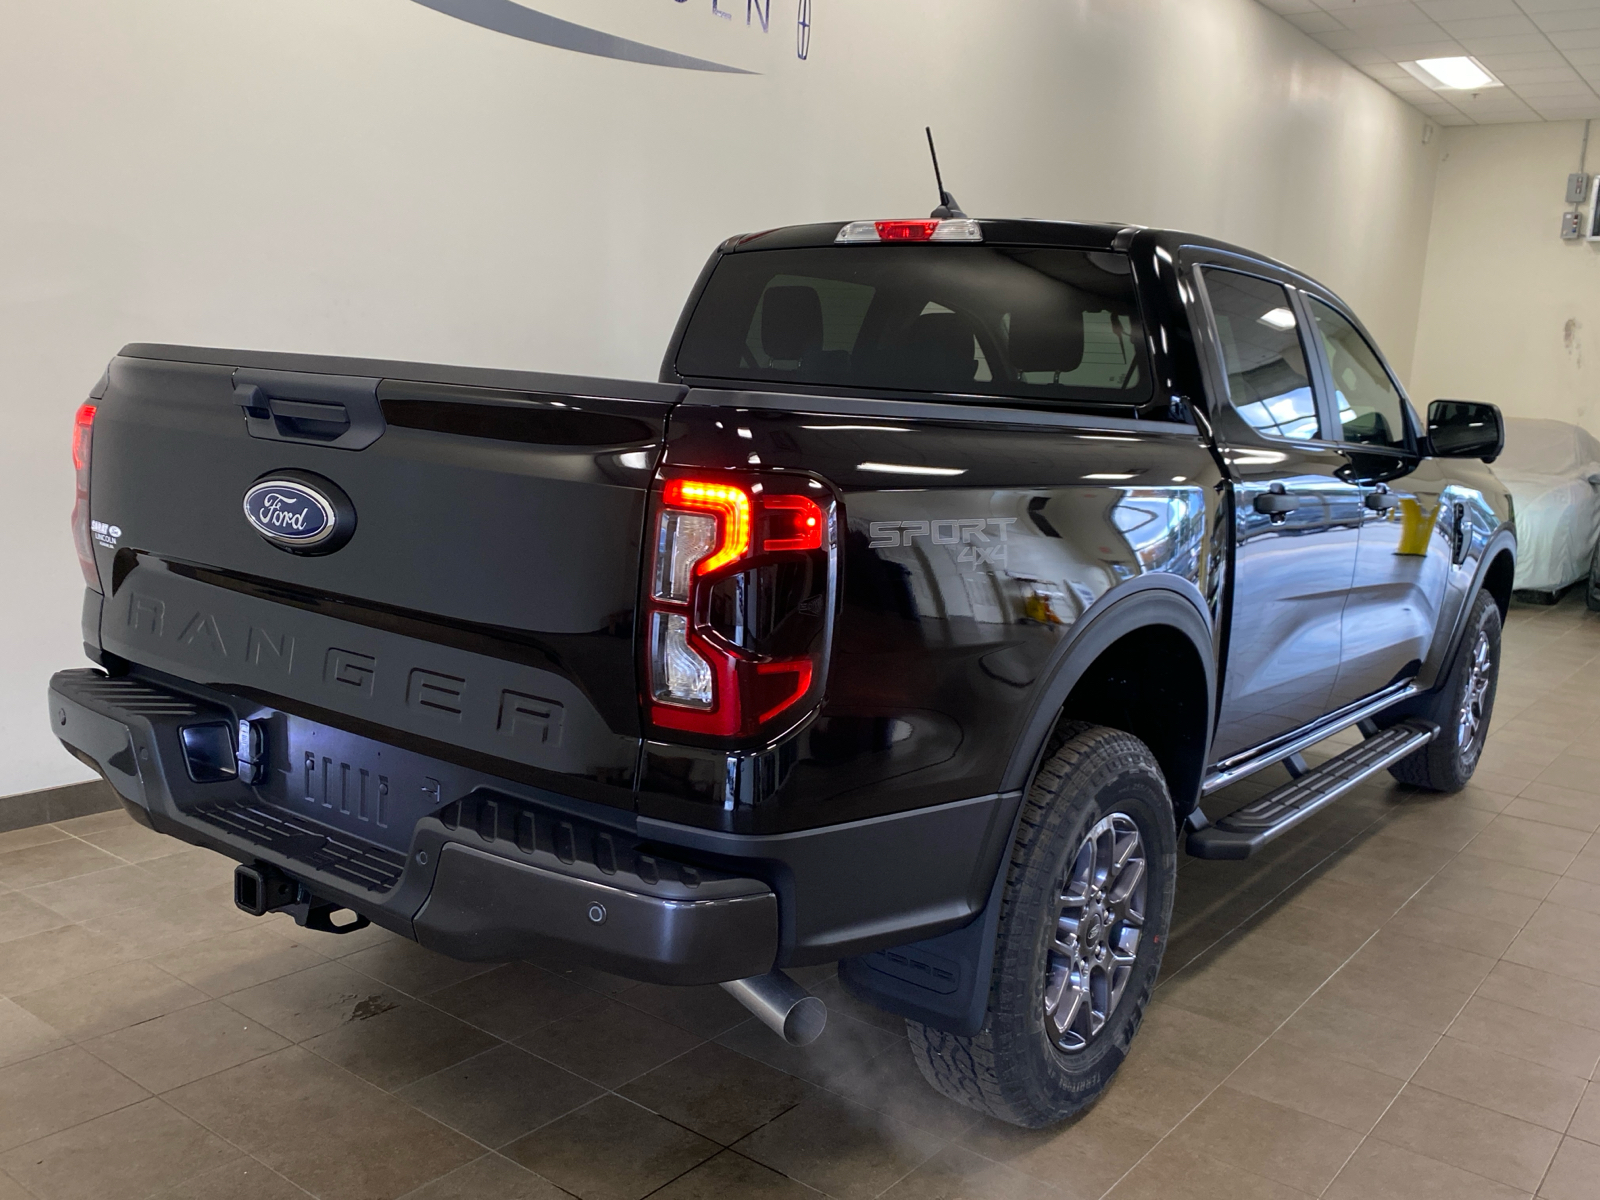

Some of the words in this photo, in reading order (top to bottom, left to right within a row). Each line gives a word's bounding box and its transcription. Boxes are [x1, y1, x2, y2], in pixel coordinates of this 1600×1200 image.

[260, 492, 309, 531] Ford
[868, 517, 1018, 549] SPORT
[127, 591, 565, 748] RANGER
